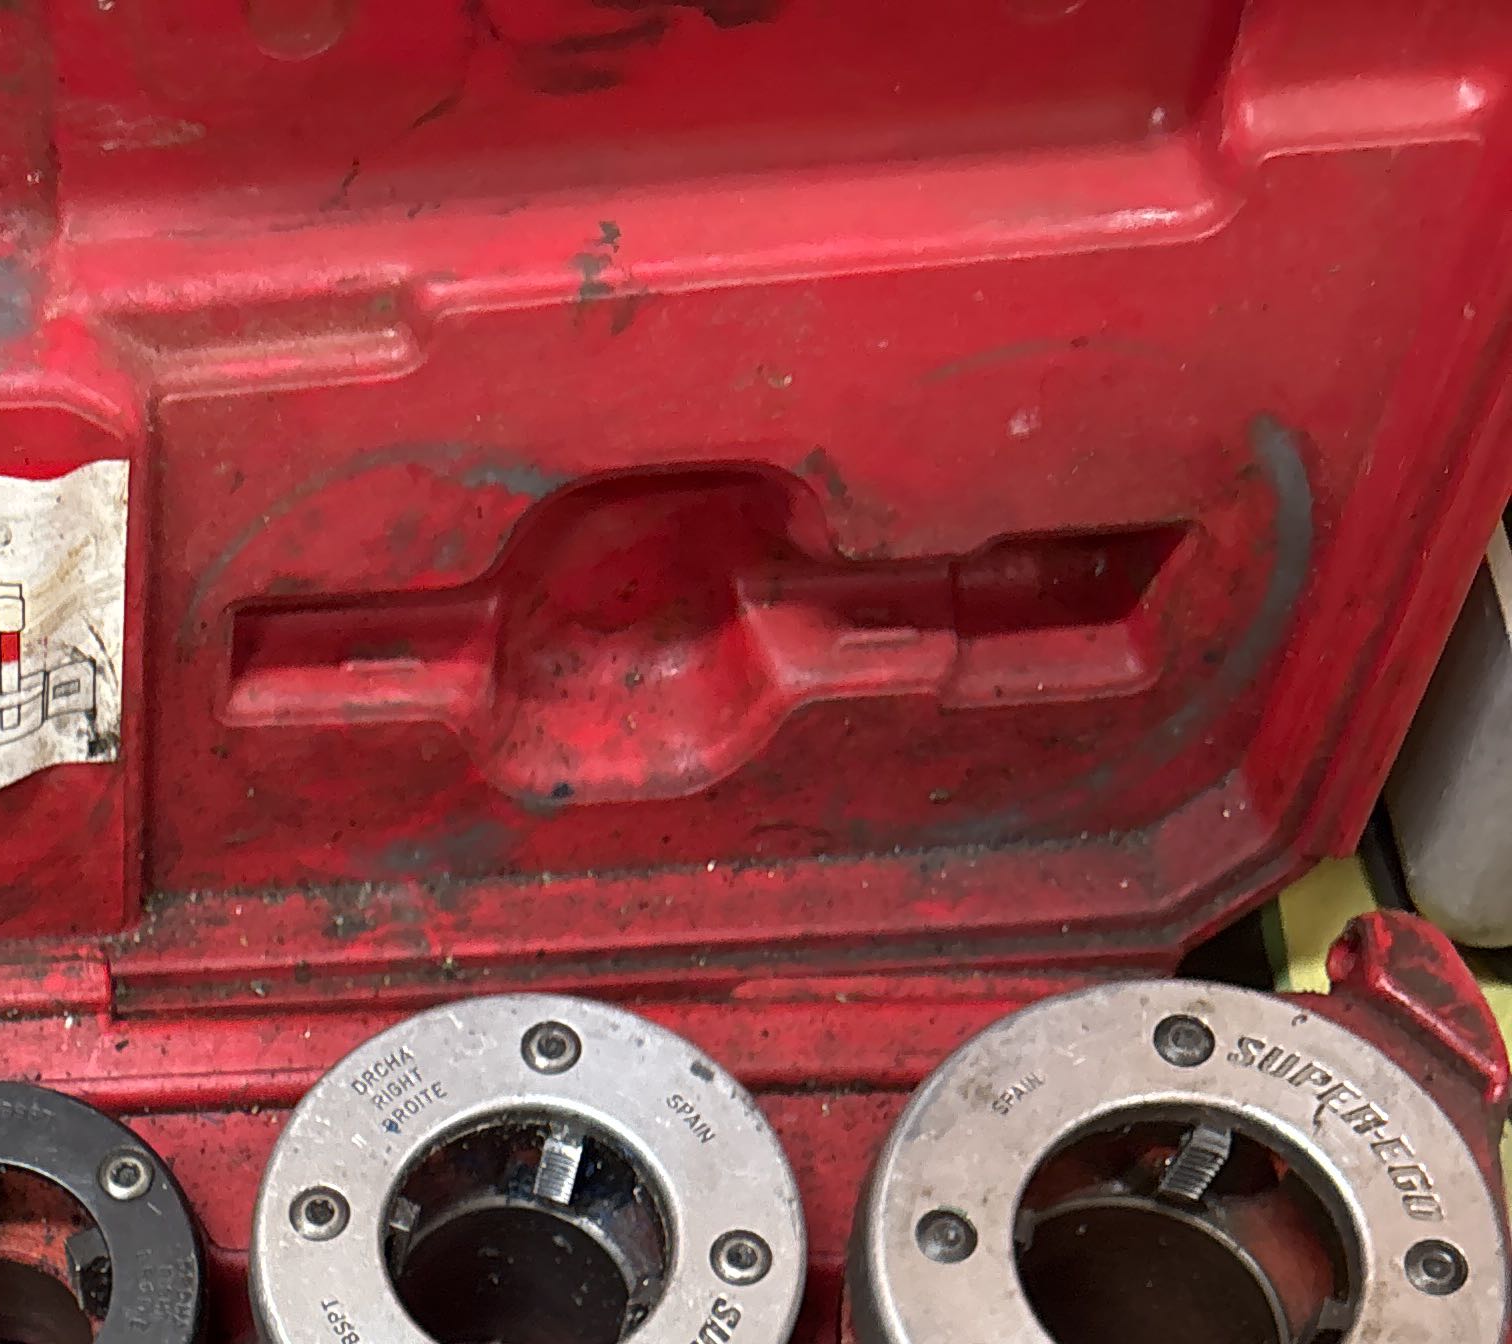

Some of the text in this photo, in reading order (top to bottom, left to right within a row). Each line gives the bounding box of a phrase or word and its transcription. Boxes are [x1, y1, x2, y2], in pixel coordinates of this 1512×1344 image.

[351, 1046, 414, 1096] DRCHA
[371, 1067, 423, 1111] RIGHT
[992, 1071, 1046, 1117] SPAIN
[382, 1081, 448, 1134] DROITE
[665, 1093, 717, 1145] SPAIN
[1228, 1036, 1448, 1222] SUPER-EGO
